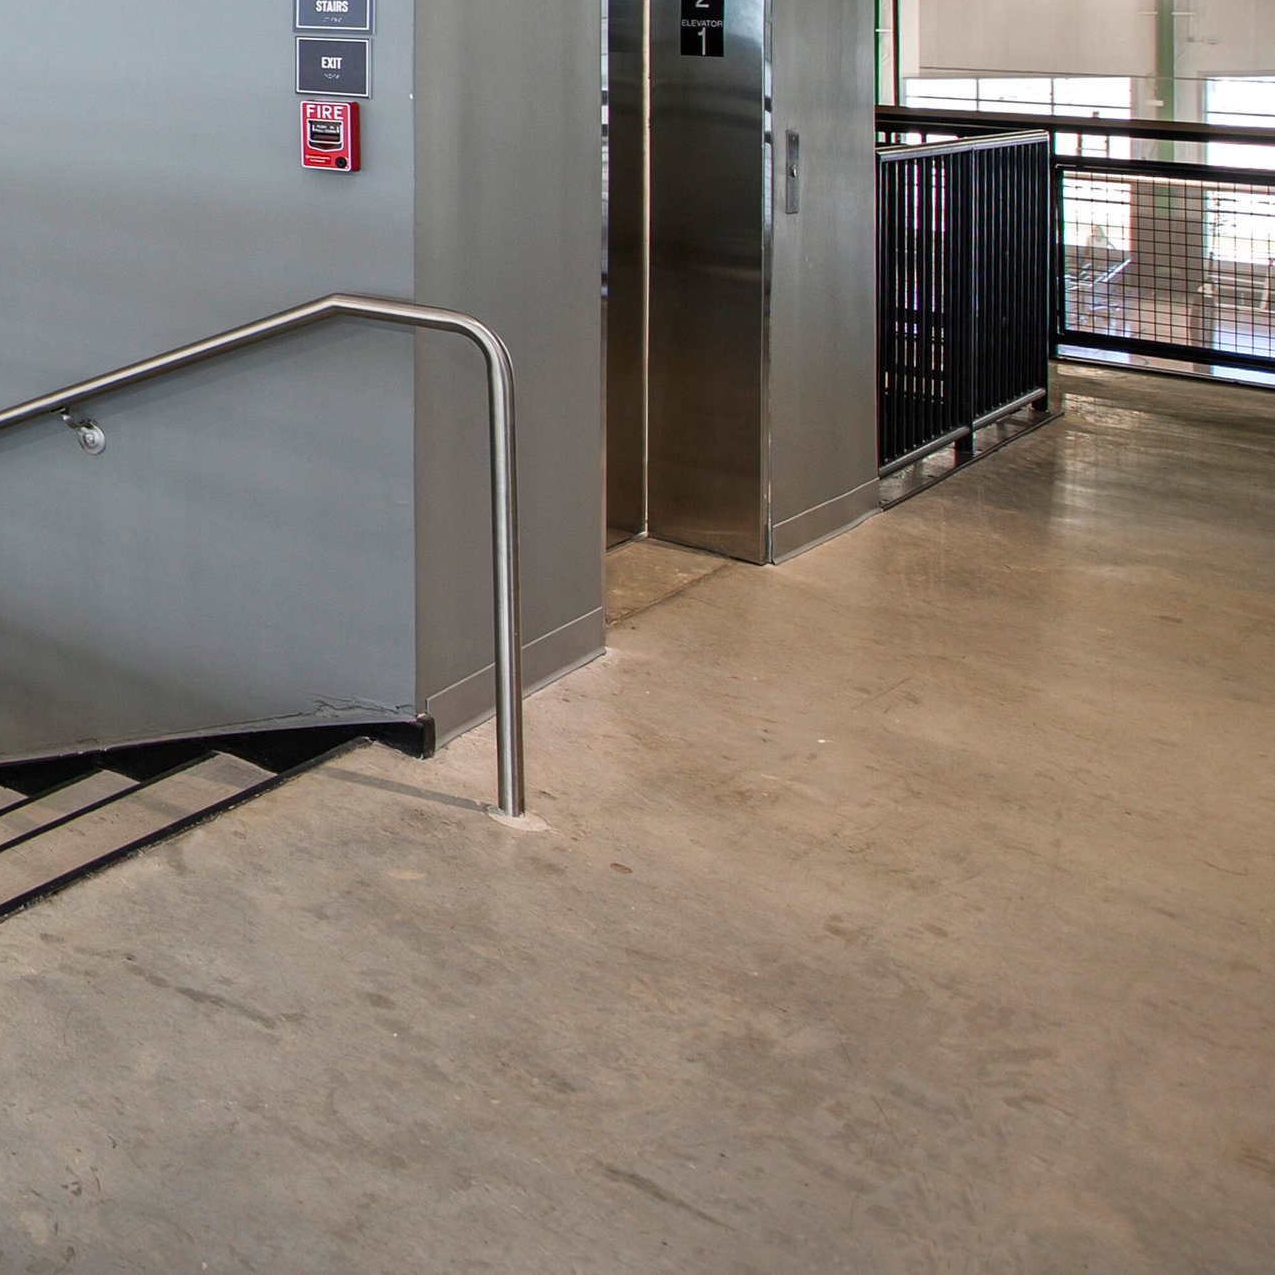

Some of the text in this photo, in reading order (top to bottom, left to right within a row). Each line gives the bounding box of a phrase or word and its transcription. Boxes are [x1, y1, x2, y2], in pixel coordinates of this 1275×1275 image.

[315, 0, 349, 13] STAIRS
[681, 19, 723, 28] ELEVATOR
[698, 27, 706, 55] 1
[322, 57, 342, 69] EXIT
[306, 104, 344, 120] FIRE
